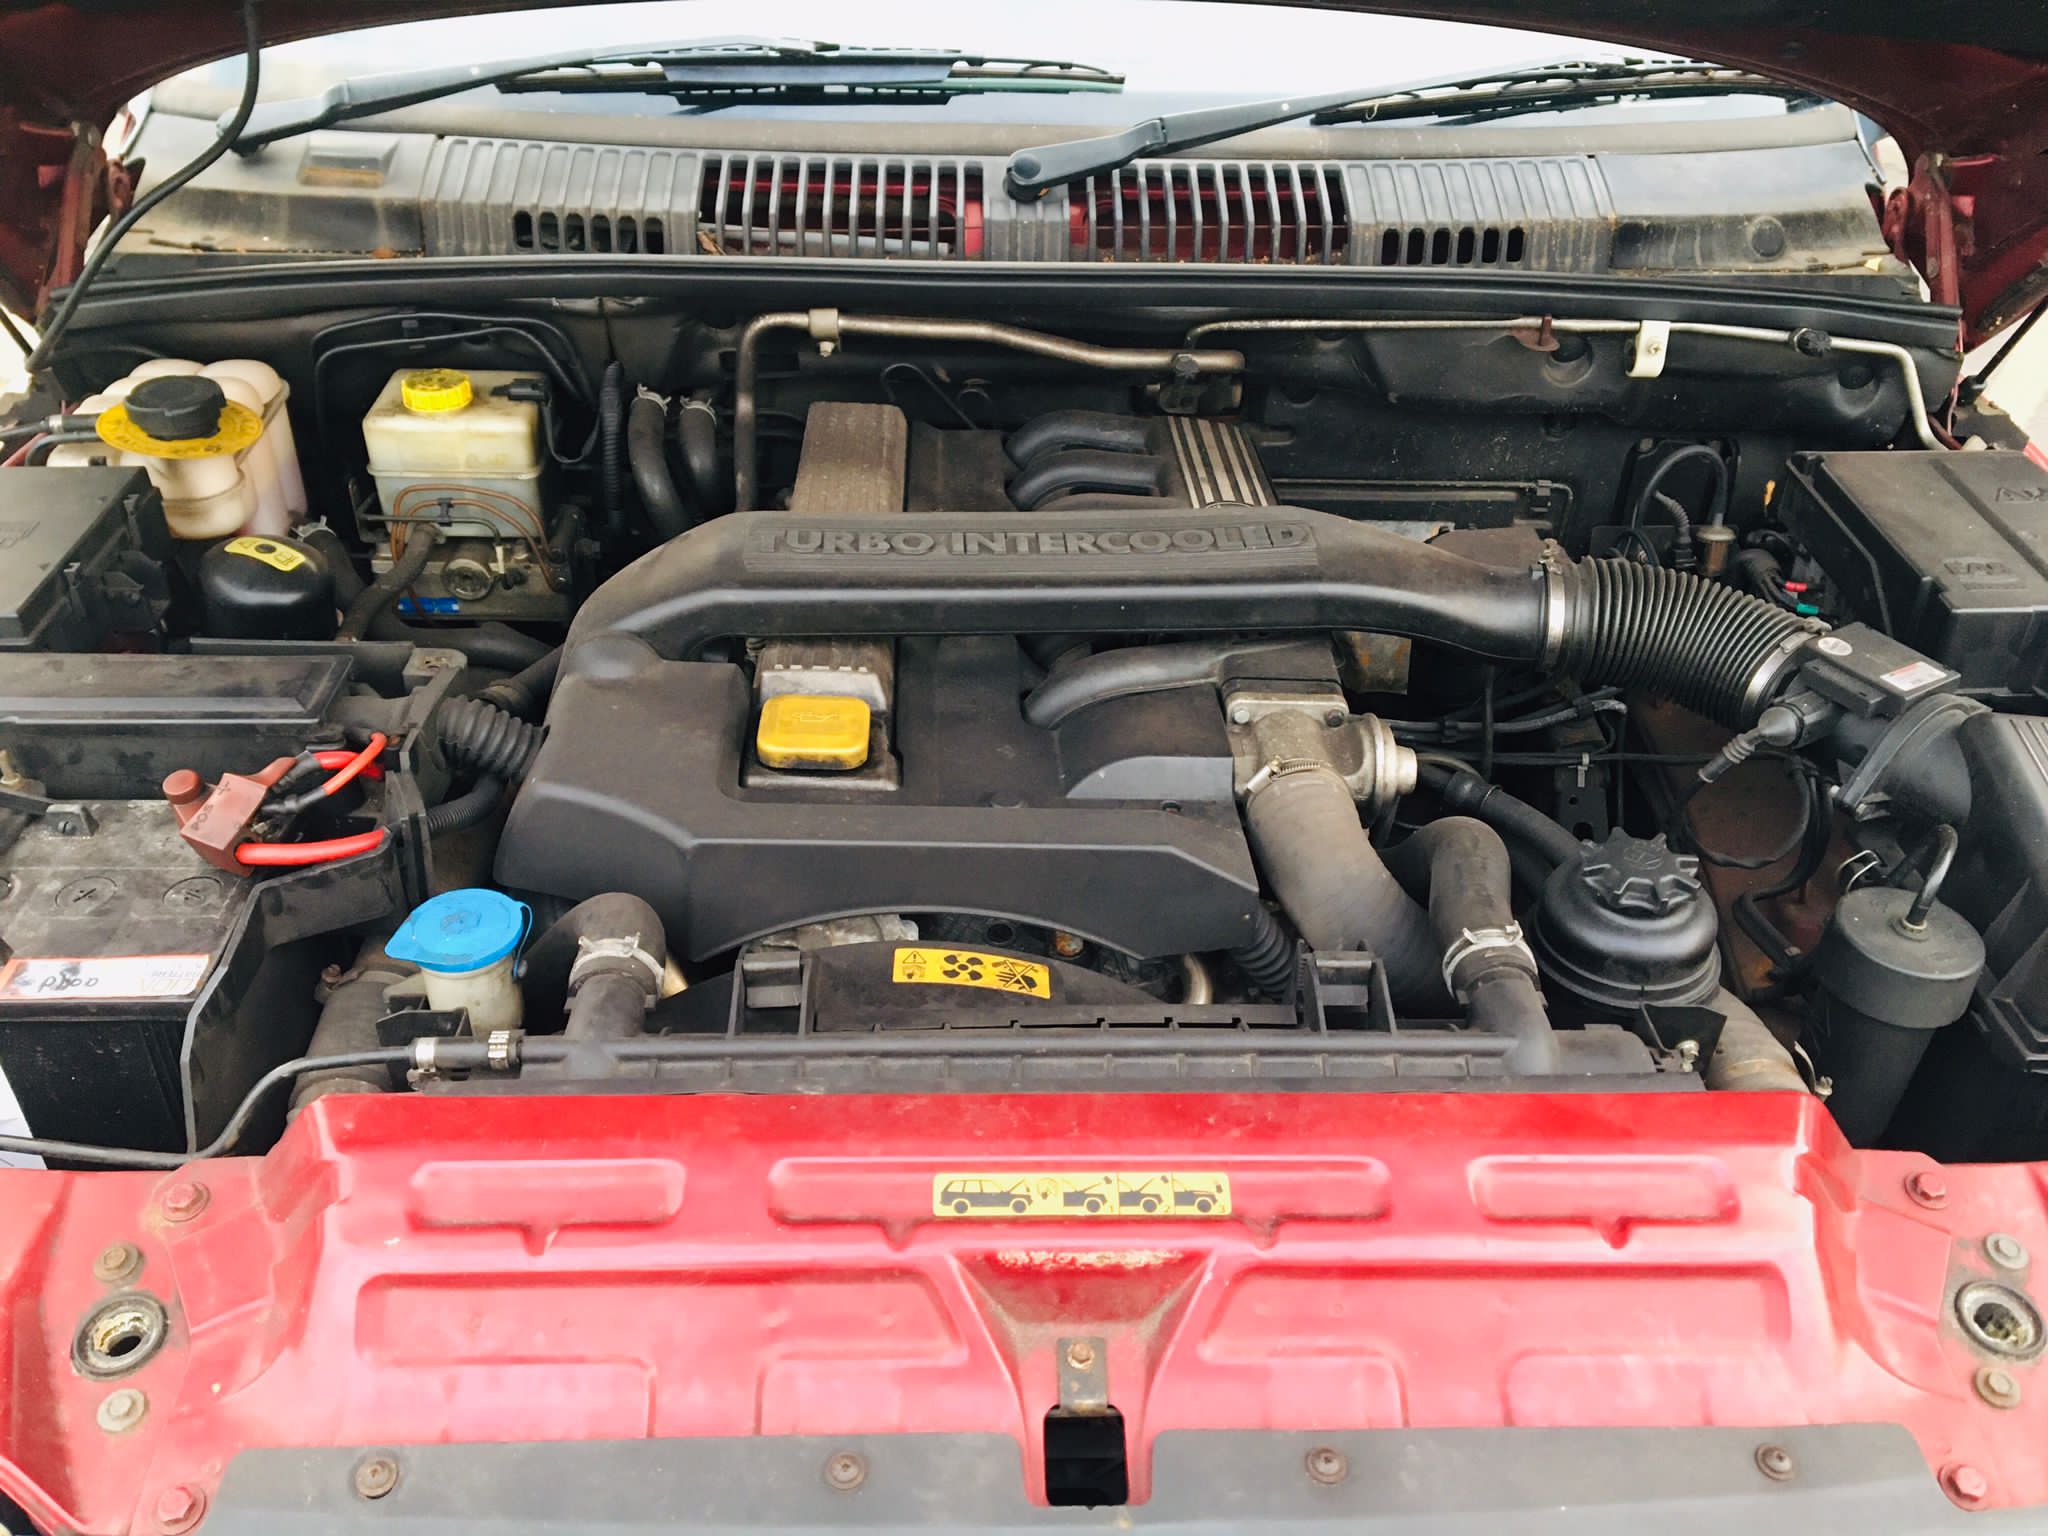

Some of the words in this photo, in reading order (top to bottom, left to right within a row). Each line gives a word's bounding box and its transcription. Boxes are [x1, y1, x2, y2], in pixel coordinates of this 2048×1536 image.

[758, 528, 935, 555] TURBO
[951, 522, 1311, 555] INTERCOOLED
[190, 803, 214, 832] POS
